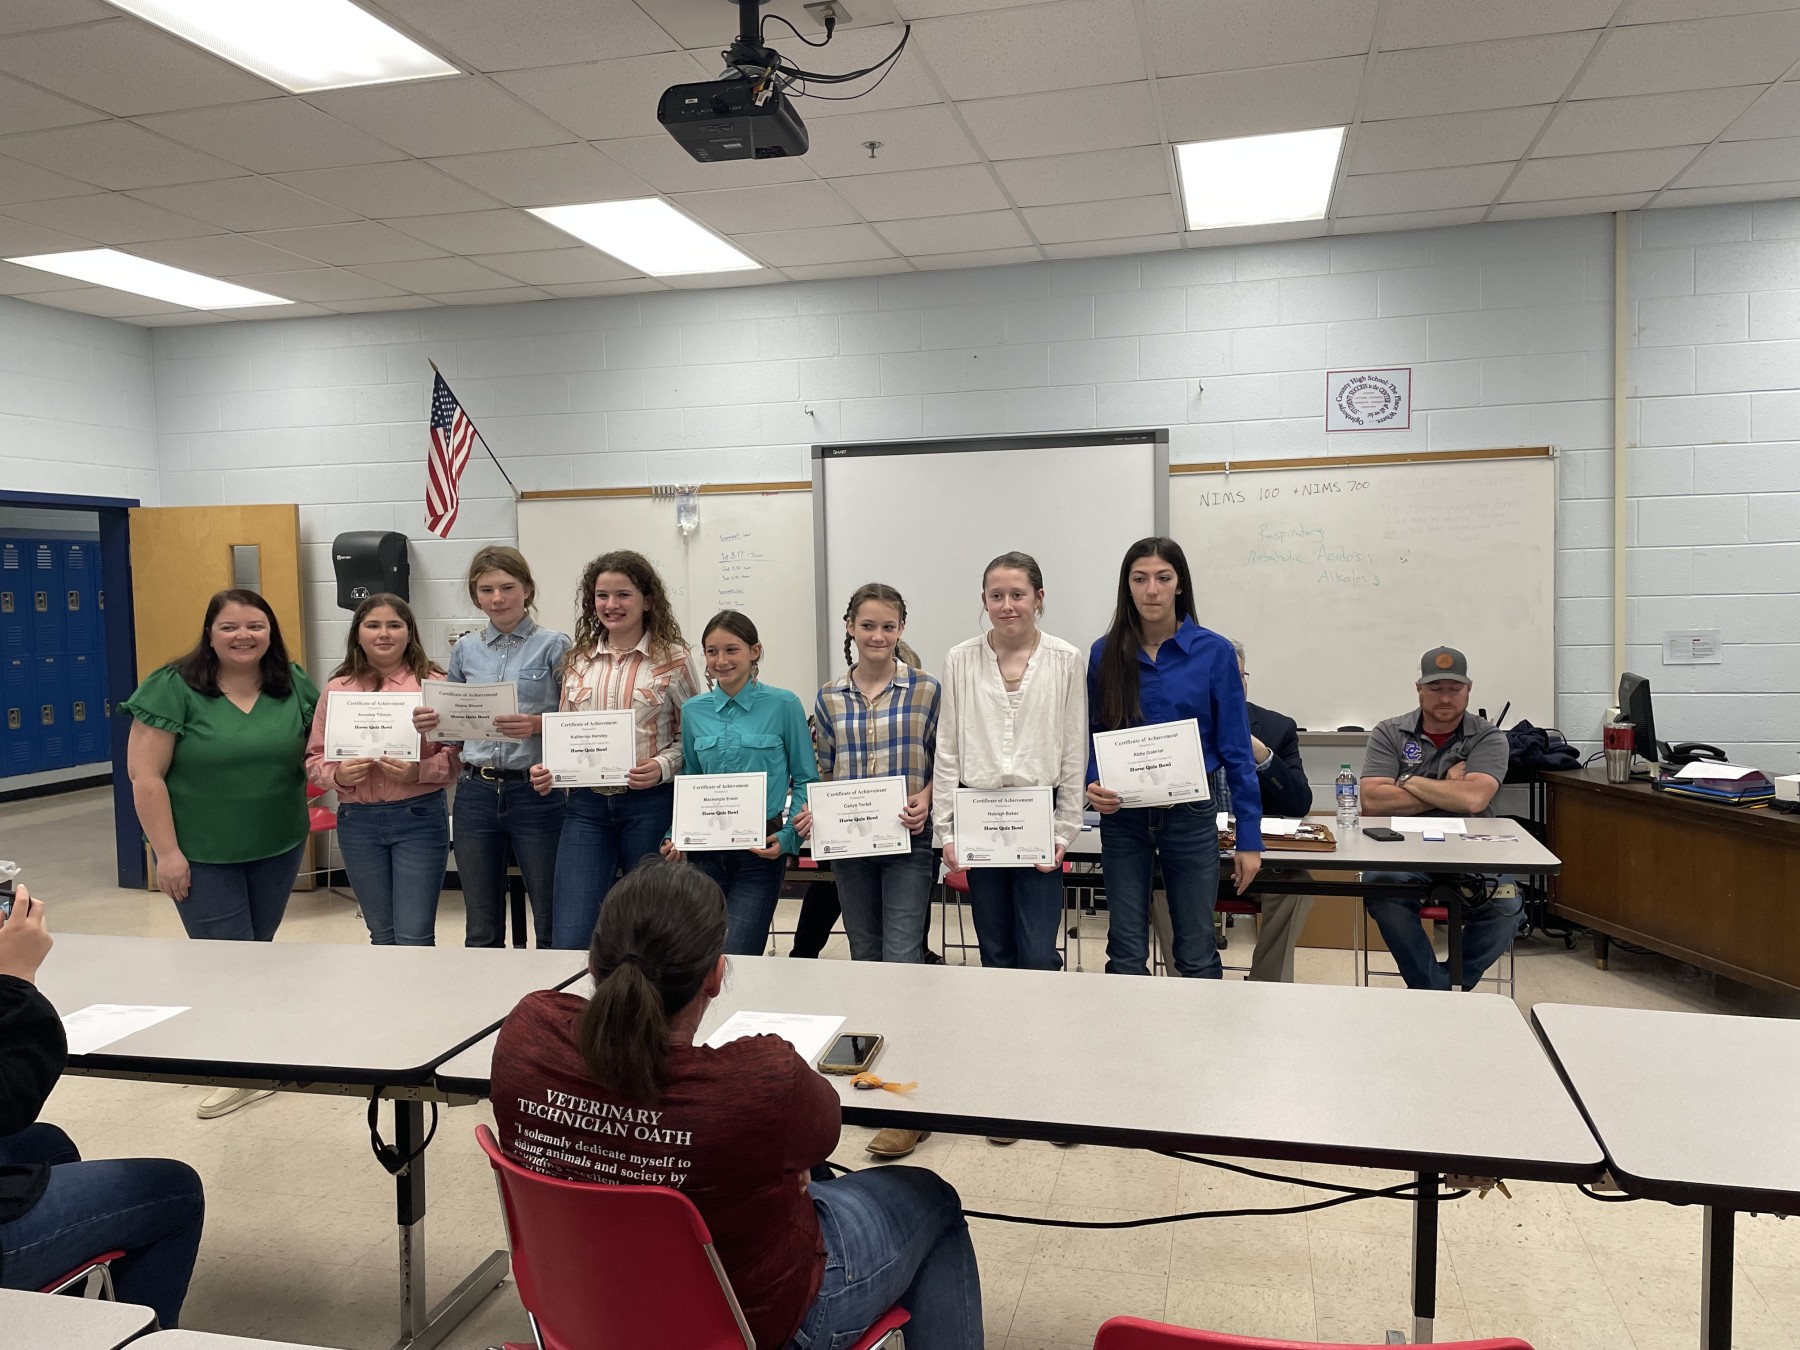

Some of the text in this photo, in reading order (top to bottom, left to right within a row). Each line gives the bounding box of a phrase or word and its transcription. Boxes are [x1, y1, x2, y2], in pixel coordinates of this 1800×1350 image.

[1336, 382, 1352, 402] County
[1350, 375, 1366, 384] High
[1388, 384, 1398, 395] The
[1348, 383, 1368, 396] SUCCESS
[1199, 492, 1246, 507] NIMS
[1259, 488, 1280, 500] 100
[1347, 480, 1370, 492] 700
[517, 1098, 692, 1146] TECHNICIAN OATH
[546, 1088, 662, 1126] VETERINARY
[514, 1138, 688, 1185] aiding animals and society by
[524, 1128, 572, 1150] solemnly
[575, 1141, 626, 1162] dedicate
[630, 1154, 675, 1168] myself
[678, 1158, 692, 1168] to
